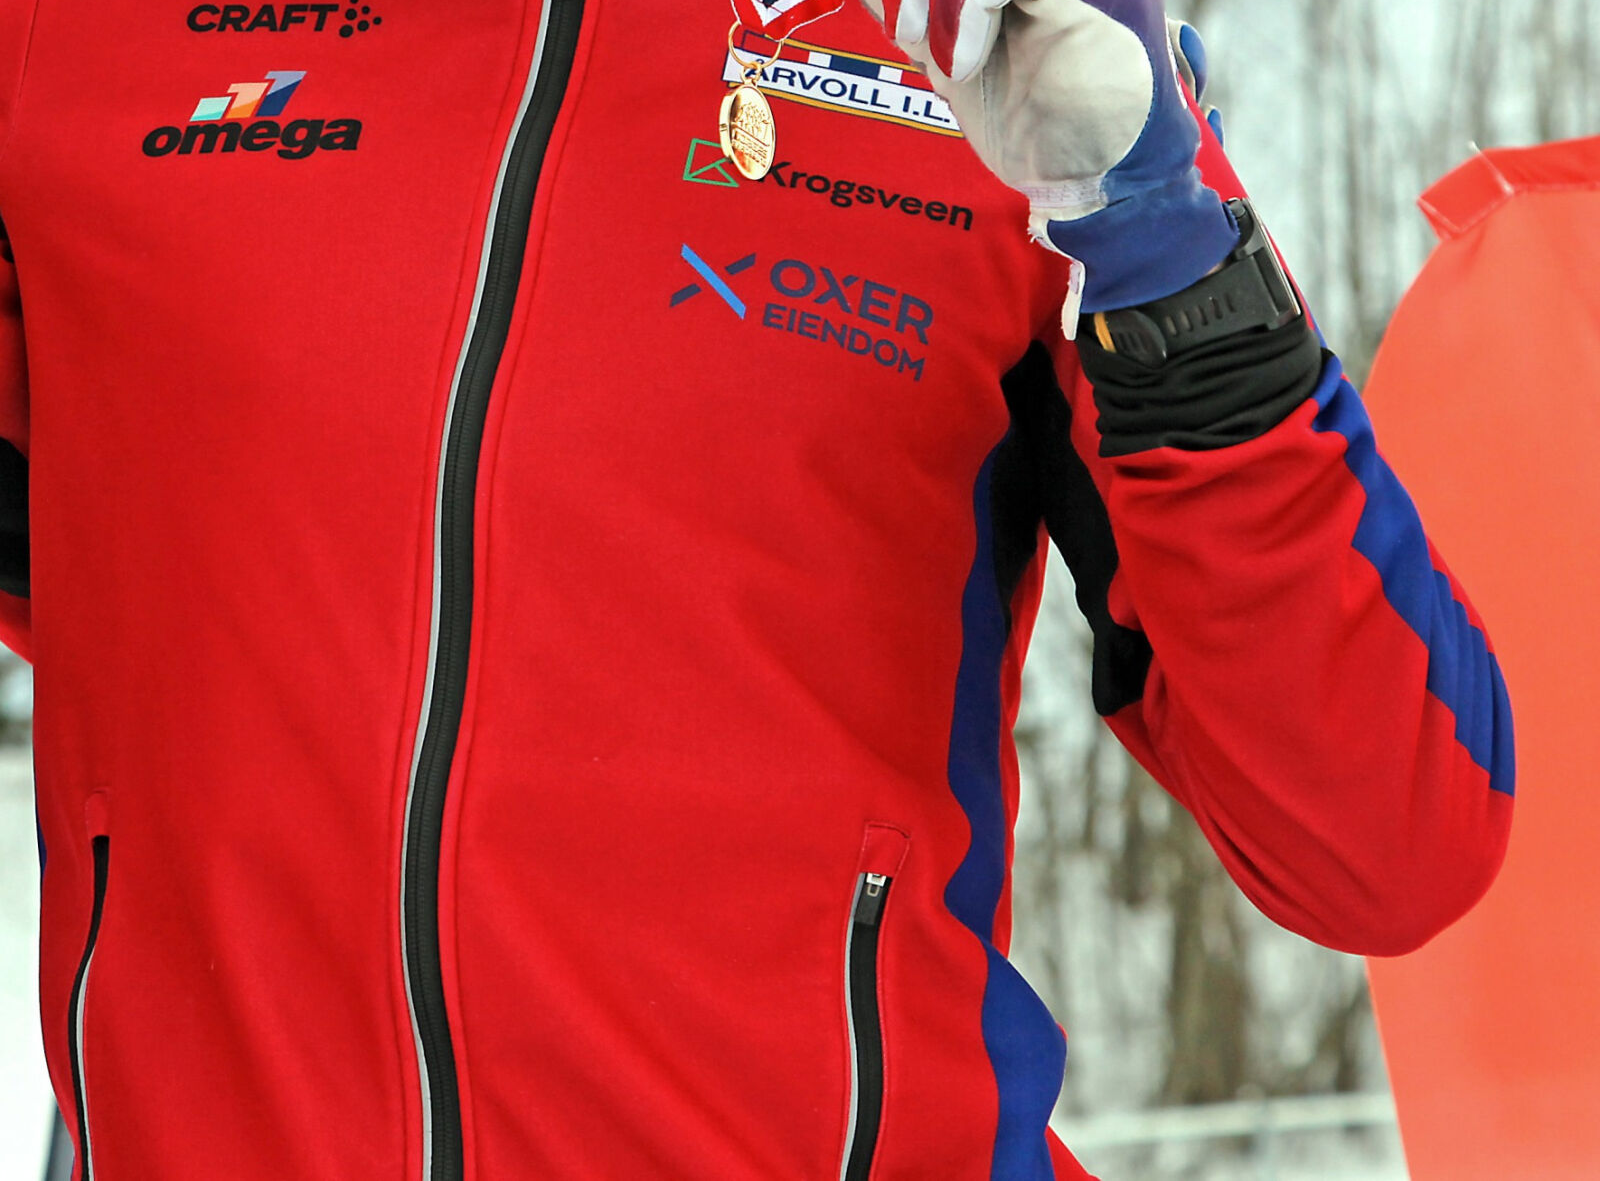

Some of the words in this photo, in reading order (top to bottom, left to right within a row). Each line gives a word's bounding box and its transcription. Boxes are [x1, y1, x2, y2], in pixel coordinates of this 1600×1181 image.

[186, 3, 340, 33] CRAFT
[745, 58, 891, 110] ÅRVOLL
[902, 95, 951, 124] I.L.
[142, 117, 363, 160] omega
[758, 161, 975, 231] Krogsveen
[769, 259, 935, 345] OXER
[762, 302, 926, 382] EIENDOM
